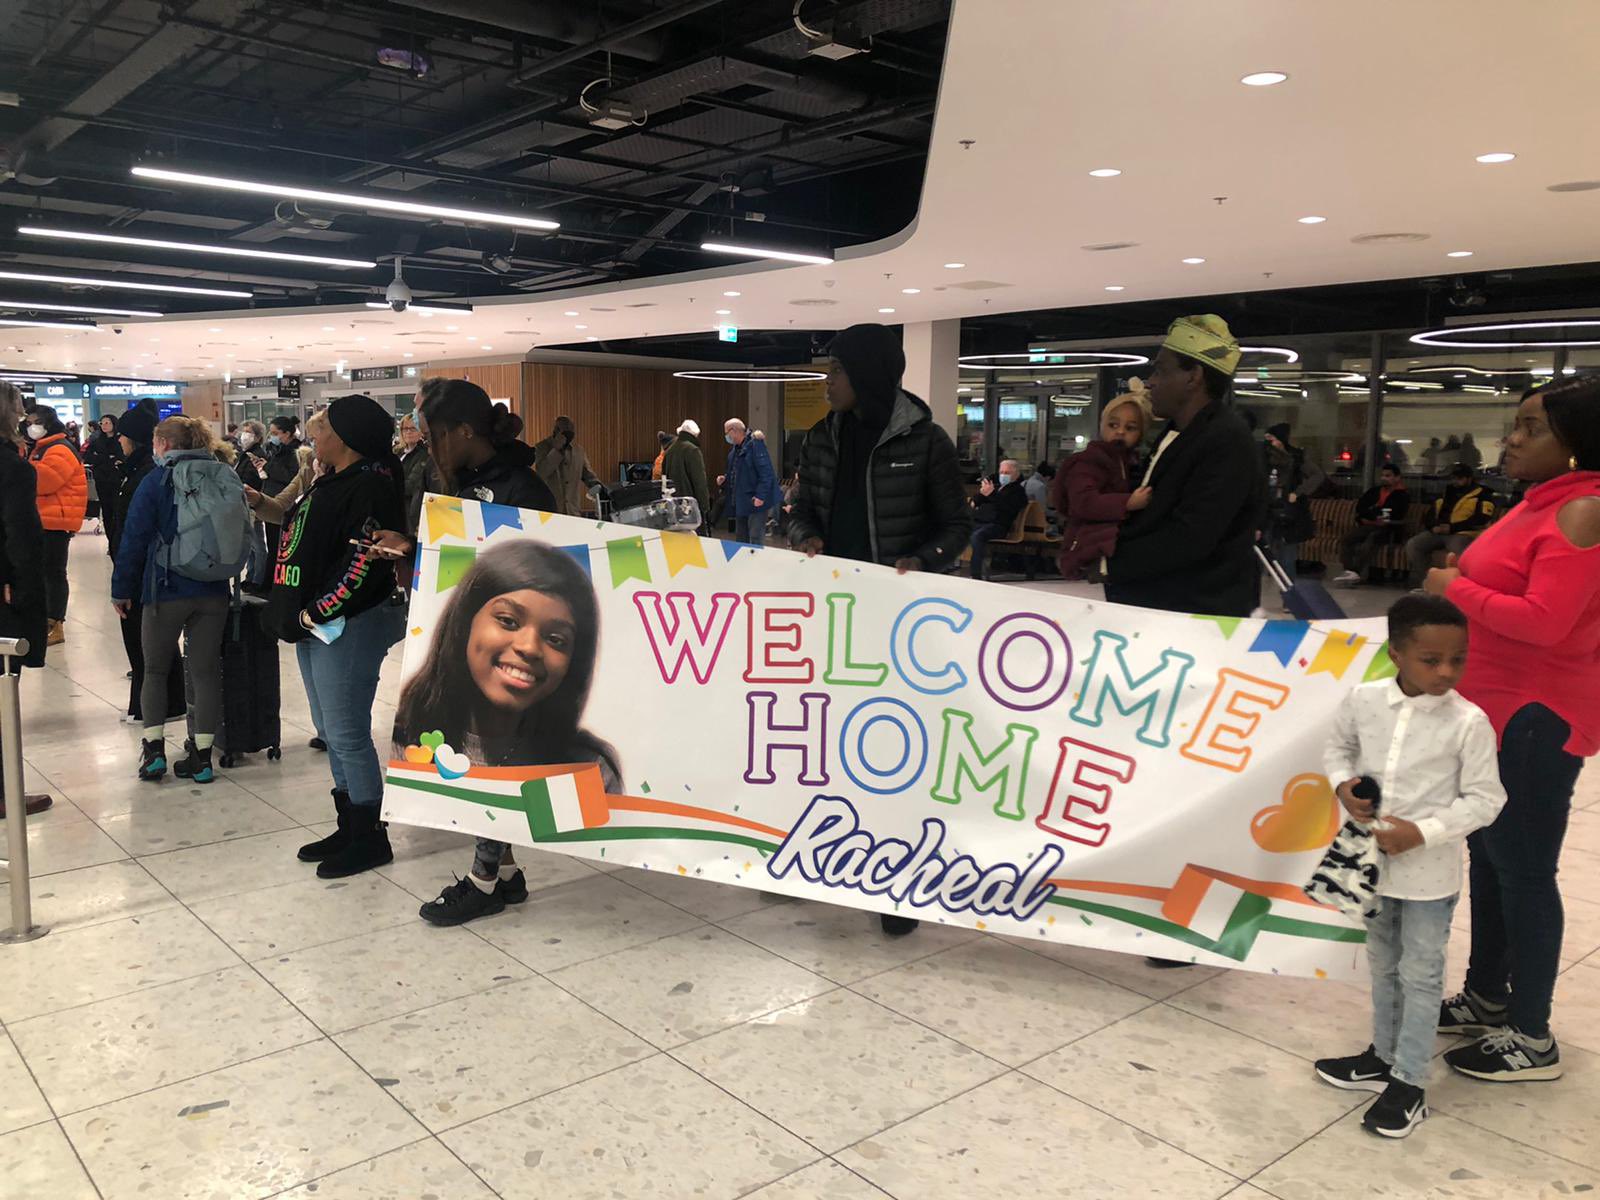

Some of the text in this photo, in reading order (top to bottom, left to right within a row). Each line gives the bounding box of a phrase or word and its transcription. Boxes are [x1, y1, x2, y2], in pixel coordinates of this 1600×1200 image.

[632, 591, 1290, 773] WELCOME
[743, 691, 1135, 848] HOME
[767, 794, 1067, 921] Racheal
[1450, 1006, 1477, 1023] N
[1503, 1051, 1532, 1070] N
